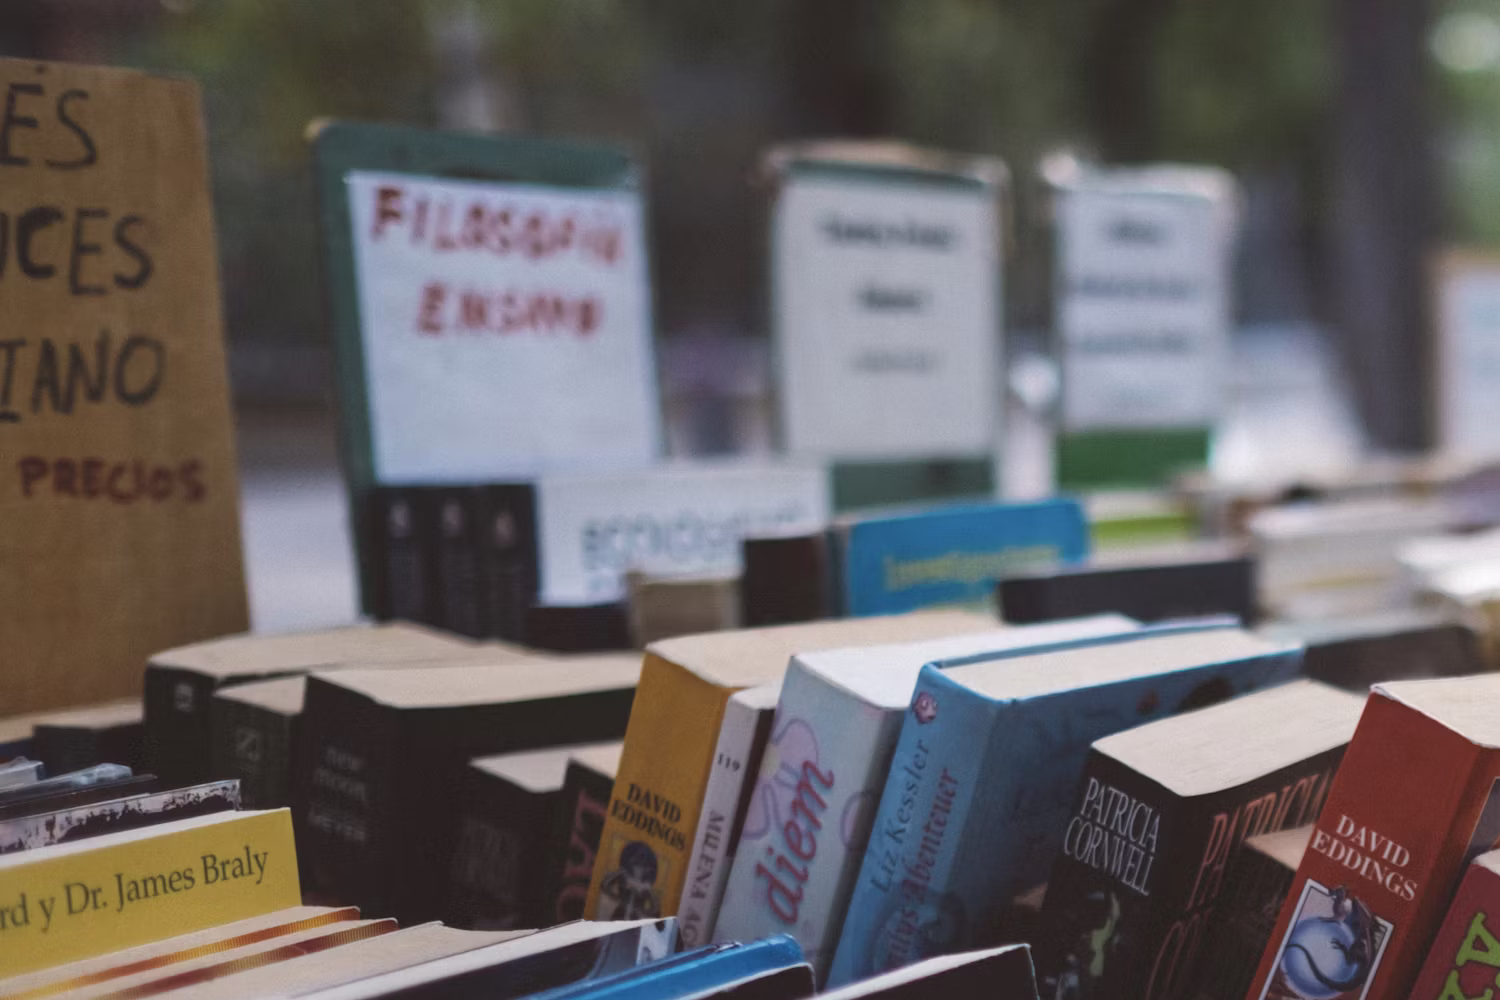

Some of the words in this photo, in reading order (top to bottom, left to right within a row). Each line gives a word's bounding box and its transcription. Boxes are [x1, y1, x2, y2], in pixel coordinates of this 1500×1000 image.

[0, 204, 154, 296] CES
[18, 455, 208, 505] PRECIOS
[716, 753, 741, 772] 119
[611, 799, 686, 850] EDDINGS
[627, 783, 682, 824] DAVID
[754, 758, 836, 927] diem
[869, 846, 898, 893] Liz
[886, 739, 930, 844] Kessler
[901, 767, 959, 903] Abenteuer
[1079, 776, 1161, 854] PATRICIA
[1334, 813, 1411, 869] DAVID
[38, 893, 57, 934] y
[63, 881, 109, 919] Dr.
[115, 866, 197, 911] James
[200, 844, 270, 887] Braly
[690, 809, 725, 899] MILENA
[1063, 815, 1156, 897] CORNWELL
[1309, 830, 1418, 902] EDDINGS
